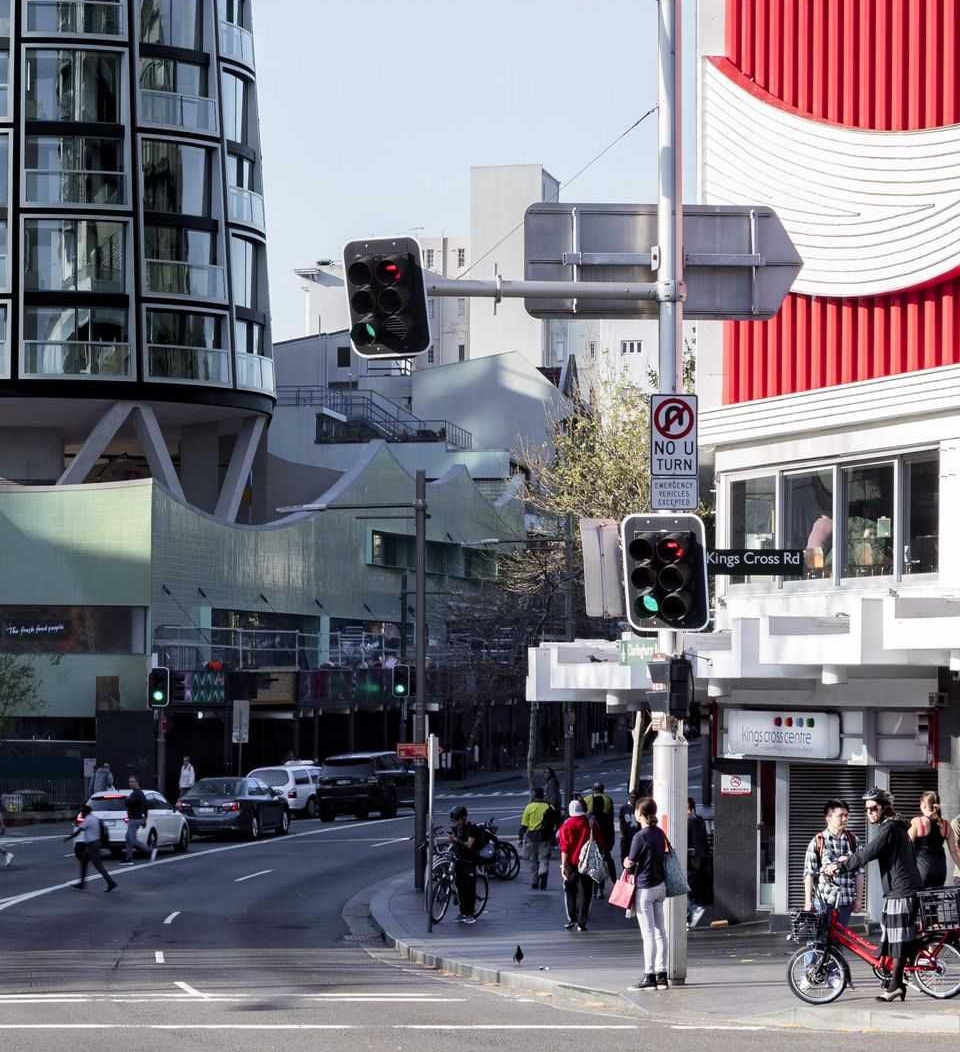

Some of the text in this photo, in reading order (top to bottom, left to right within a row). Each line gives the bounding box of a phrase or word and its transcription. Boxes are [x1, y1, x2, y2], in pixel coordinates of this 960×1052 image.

[655, 441, 694, 455] NO U
[656, 458, 692, 471] TURN
[706, 551, 800, 568] Kings Cross Rd
[6, 625, 19, 635] The
[20, 625, 35, 636] fresh
[35, 624, 48, 634] food
[48, 623, 64, 633] people
[741, 727, 812, 746] kings cross centre
